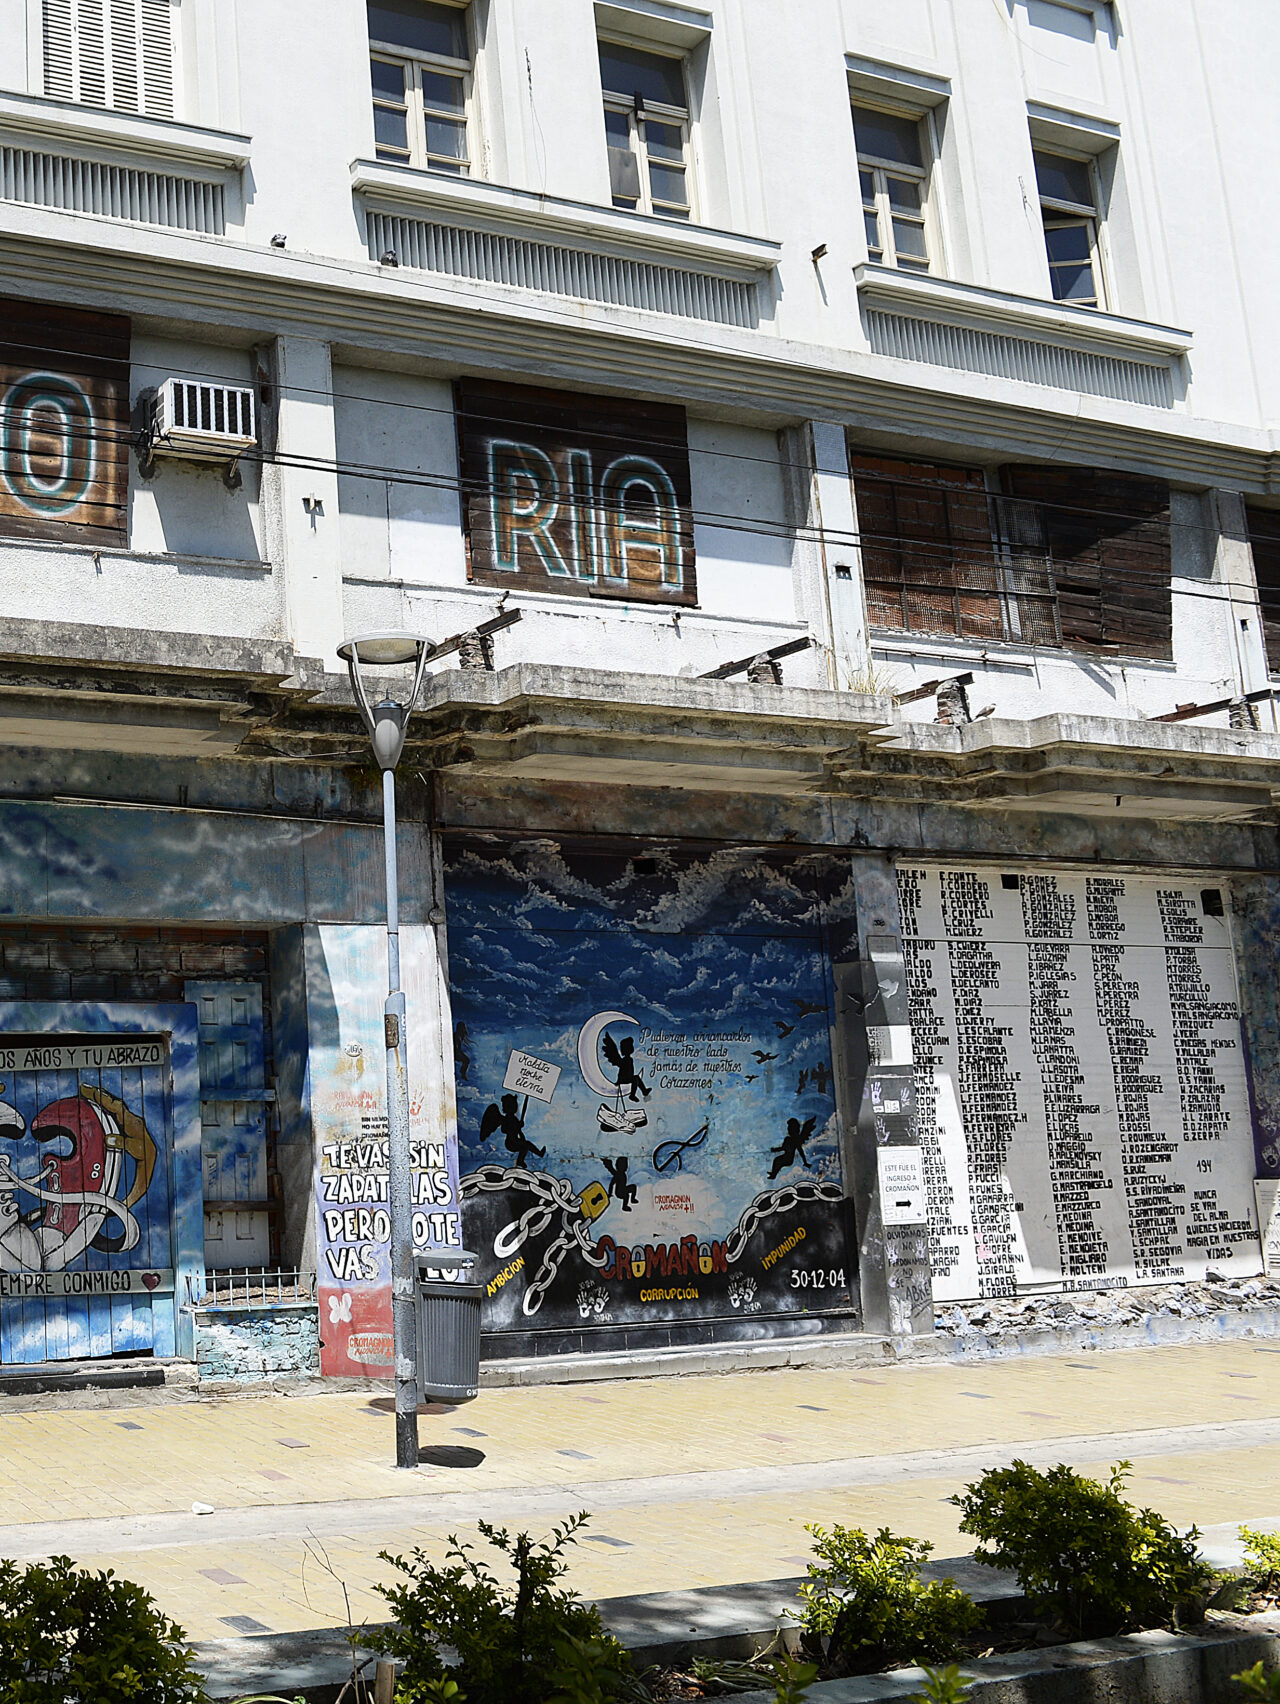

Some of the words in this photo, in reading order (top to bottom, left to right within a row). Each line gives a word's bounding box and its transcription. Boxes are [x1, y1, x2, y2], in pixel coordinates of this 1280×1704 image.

[488, 437, 684, 591] RIA
[693, 1026, 752, 1042] arrancarlos
[24, 1049, 62, 1068] AÑOS
[67, 1049, 77, 1067] Y
[81, 1049, 103, 1066] TU
[107, 1046, 160, 1064] ABRAZO
[646, 1044, 659, 1057] de
[664, 1045, 701, 1057] nuestro
[706, 1044, 728, 1057] lado
[685, 1061, 698, 1072] de
[703, 1060, 742, 1073] nuestros
[1196, 1160, 1212, 1173] 194
[321, 1171, 452, 1206] ZAPATLAS
[885, 1184, 919, 1192] CROMAÑON
[1194, 1190, 1217, 1200] NUNCA
[1190, 1202, 1199, 1212] SE
[1203, 1201, 1217, 1211] VAN
[1193, 1212, 1207, 1222] DEL
[1209, 1211, 1228, 1221] ALMA
[324, 1208, 391, 1243] PERO
[1186, 1223, 1217, 1235] QUIENES
[1218, 1221, 1251, 1231] HICIERON
[903, 1242, 913, 1251] NO
[1187, 1236, 1209, 1247] MAGIA
[1210, 1235, 1220, 1245] EN
[1223, 1231, 1260, 1242] NUESTRAS
[760, 1226, 807, 1271] IMPUNIDAD
[1206, 1247, 1233, 1259] VIDAS
[326, 1244, 379, 1281] VAS
[63, 1271, 132, 1294] CONMIGO
[486, 1256, 526, 1298] AMBICION
